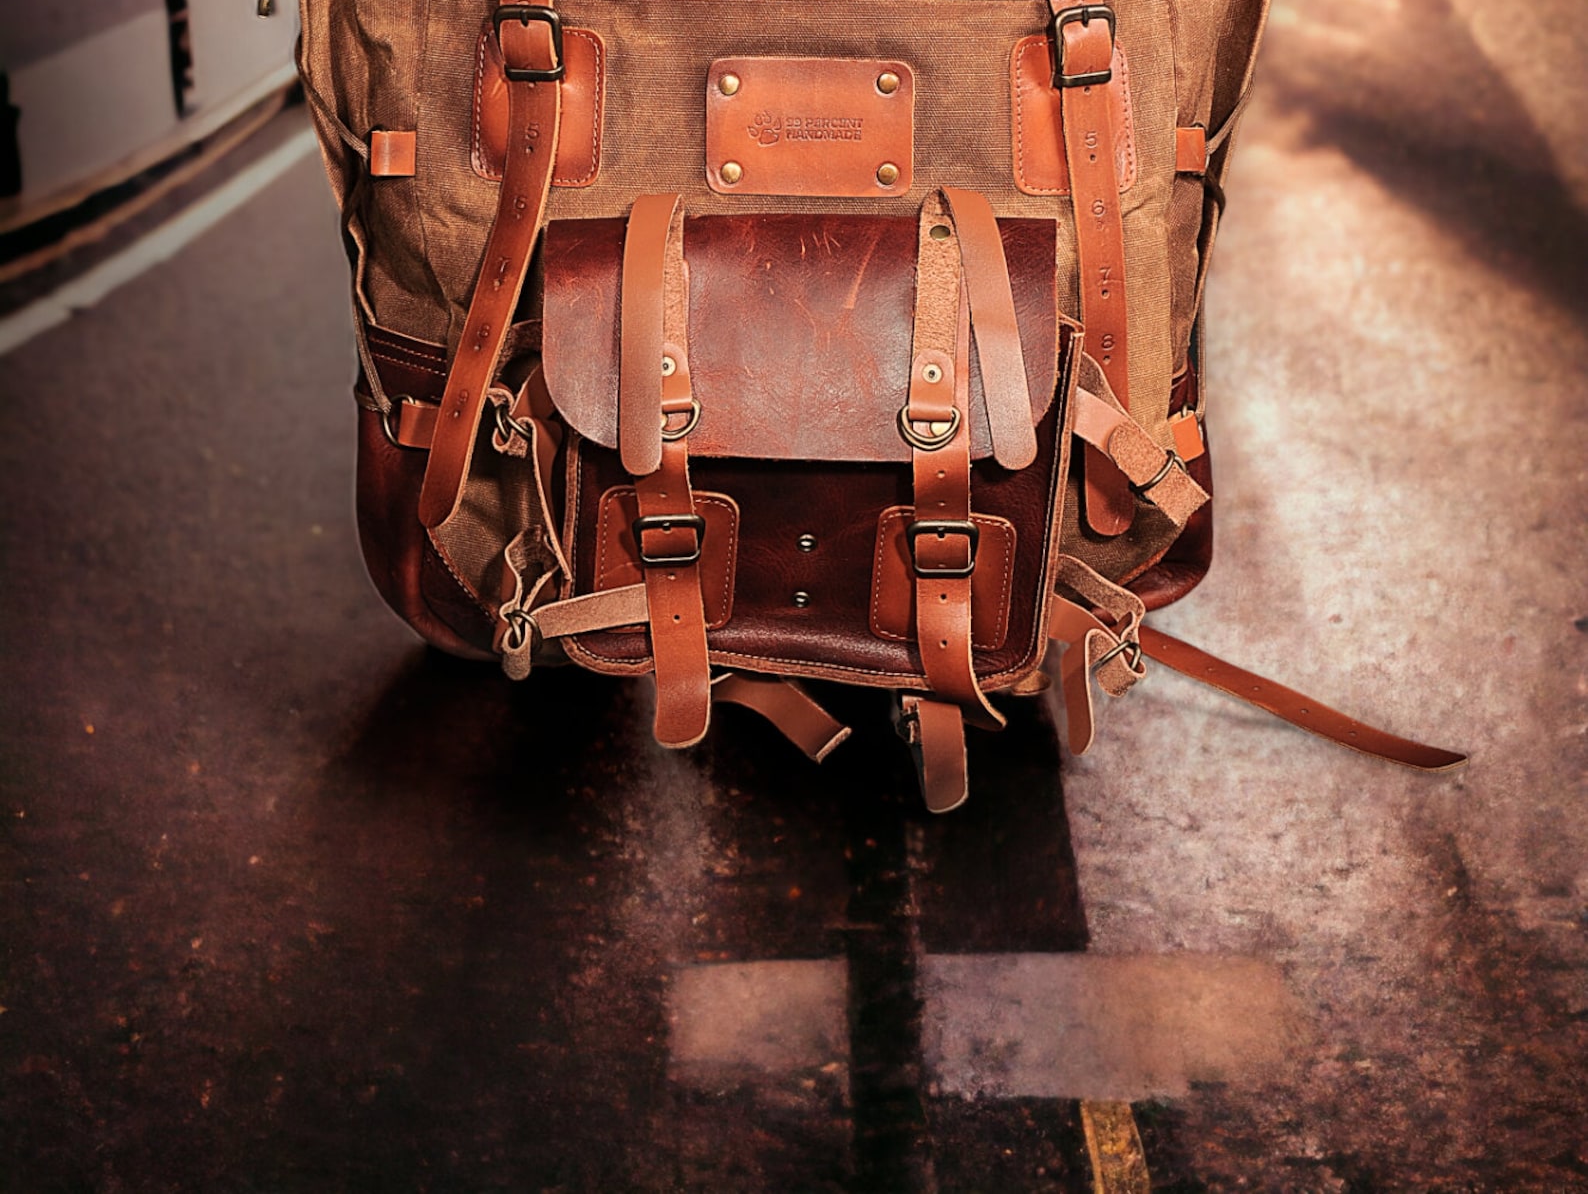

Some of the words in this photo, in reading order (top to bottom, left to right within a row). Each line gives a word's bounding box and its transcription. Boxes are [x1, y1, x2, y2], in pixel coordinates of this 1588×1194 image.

[526, 122, 539, 139] 5
[805, 117, 864, 128] PERCENT
[786, 129, 862, 141] HANDMADE
[1085, 131, 1098, 148] 5
[1091, 199, 1105, 217] 6
[1099, 266, 1112, 285] 7
